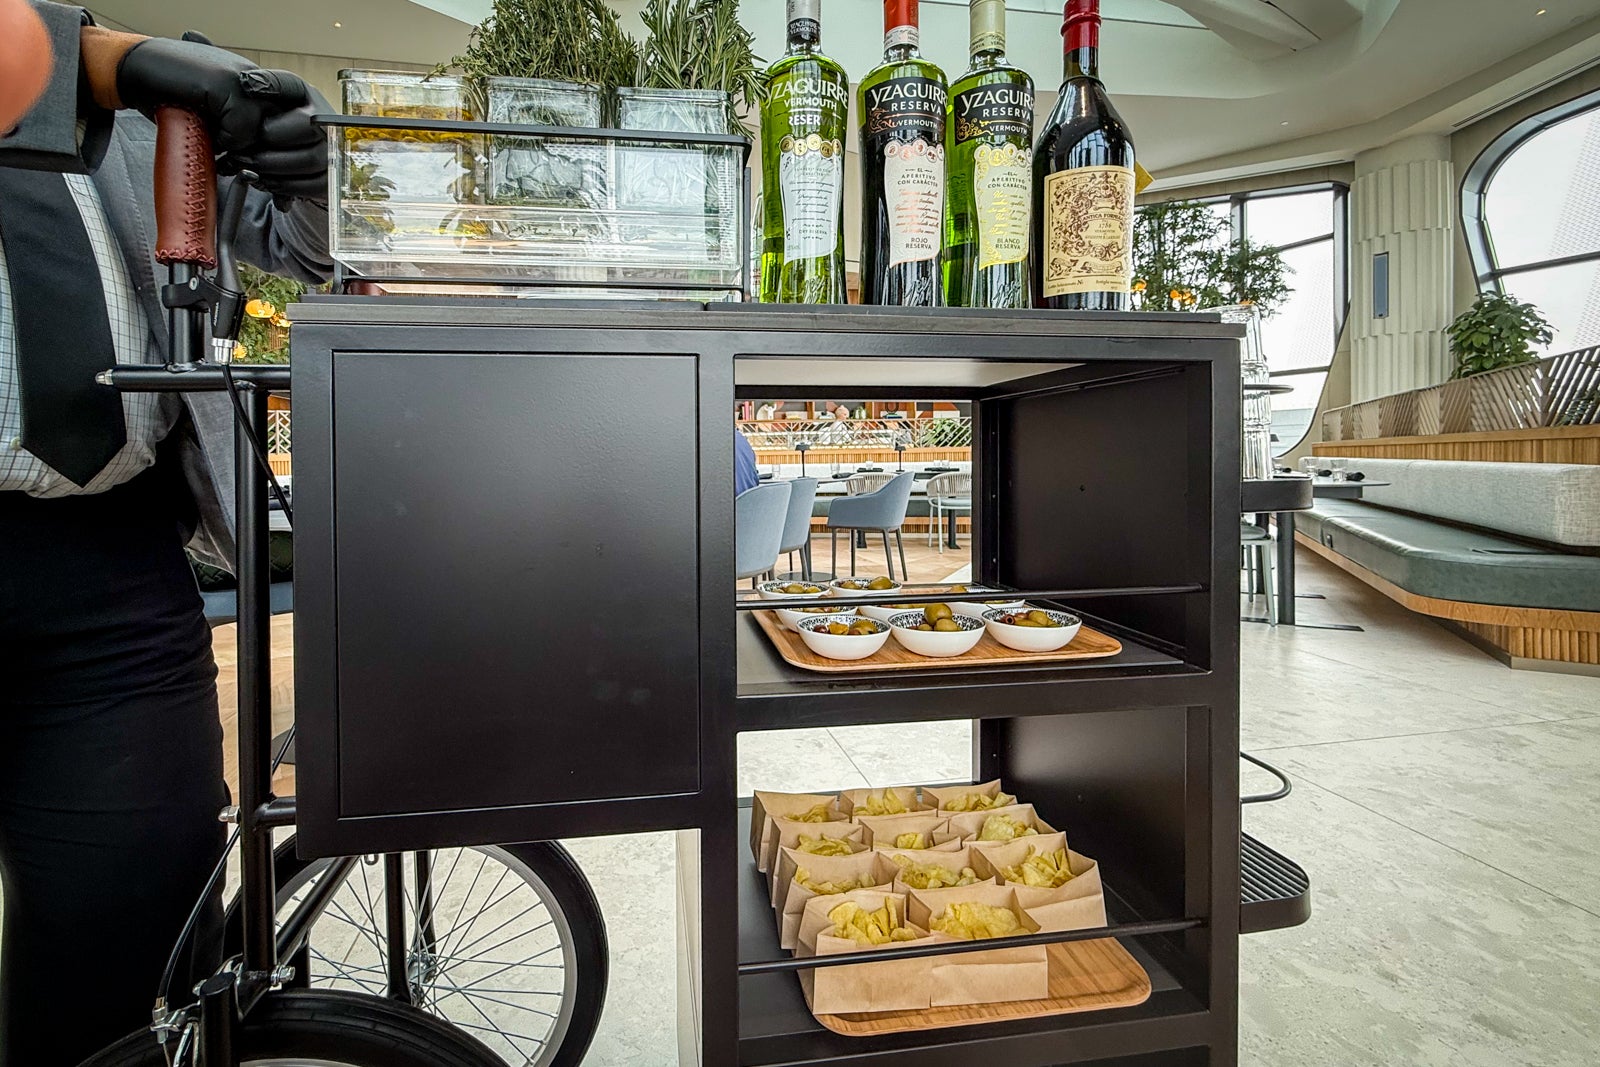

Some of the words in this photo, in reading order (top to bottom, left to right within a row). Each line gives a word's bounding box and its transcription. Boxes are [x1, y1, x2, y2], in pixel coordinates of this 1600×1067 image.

[784, 97, 837, 110] VERMOUTH
[891, 101, 942, 115] RESERVA
[982, 107, 1031, 121] RESERVA
[898, 119, 938, 129] VERMOUTH
[990, 125, 1028, 135] VERMOUTH
[901, 173, 936, 181] APERITIVO
[991, 177, 1026, 185] APERITIVO
[1082, 213, 1103, 221] ANTICA
[996, 237, 1021, 245] BLANCO
